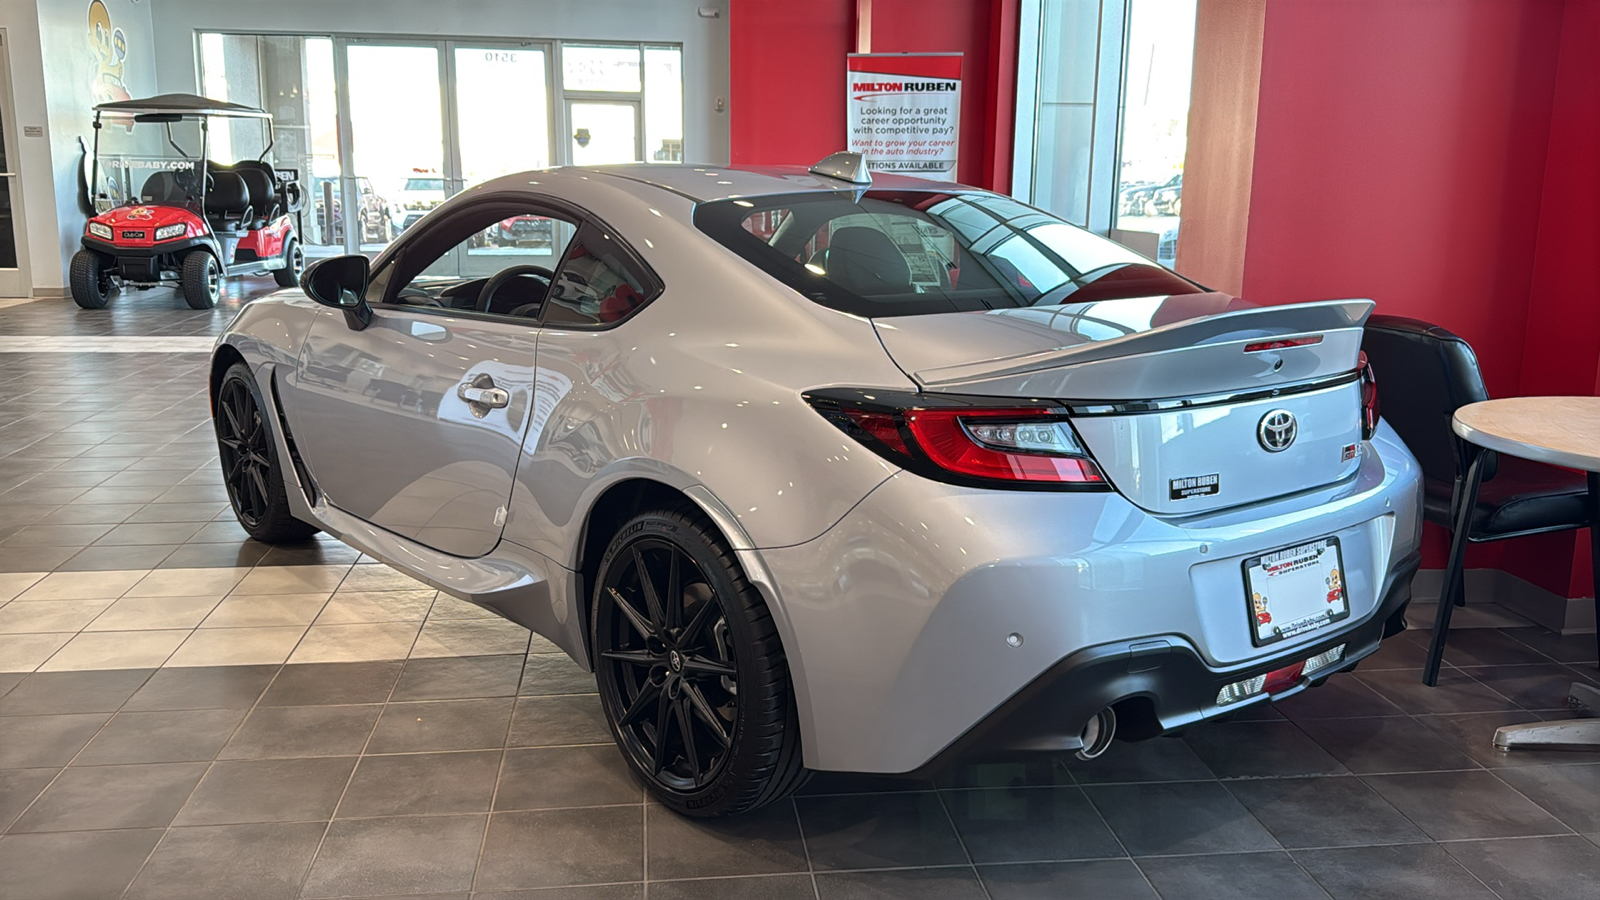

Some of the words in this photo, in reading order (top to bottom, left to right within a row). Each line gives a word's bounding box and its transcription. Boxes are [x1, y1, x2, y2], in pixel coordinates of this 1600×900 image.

[853, 82, 902, 92] MILTON
[904, 82, 957, 92] RUBEN
[860, 107, 897, 116] Looking
[899, 107, 912, 115] for
[923, 107, 948, 116] great
[861, 117, 889, 125] career
[892, 117, 947, 126] opportunity
[853, 126, 873, 134] with
[875, 126, 930, 135] competitive
[932, 126, 954, 135] pay?
[852, 139, 873, 147] Want
[874, 139, 883, 147] to
[885, 140, 907, 148] grow
[908, 140, 927, 148] your
[928, 139, 955, 147] career
[906, 147, 944, 156] industry?
[867, 162, 896, 170] ITIONS
[1172, 477, 1197, 490] MILTON
[1197, 474, 1218, 487] RUBEN
[1293, 554, 1319, 566] RUBEN
[1279, 560, 1320, 575] SUPERSTORE
